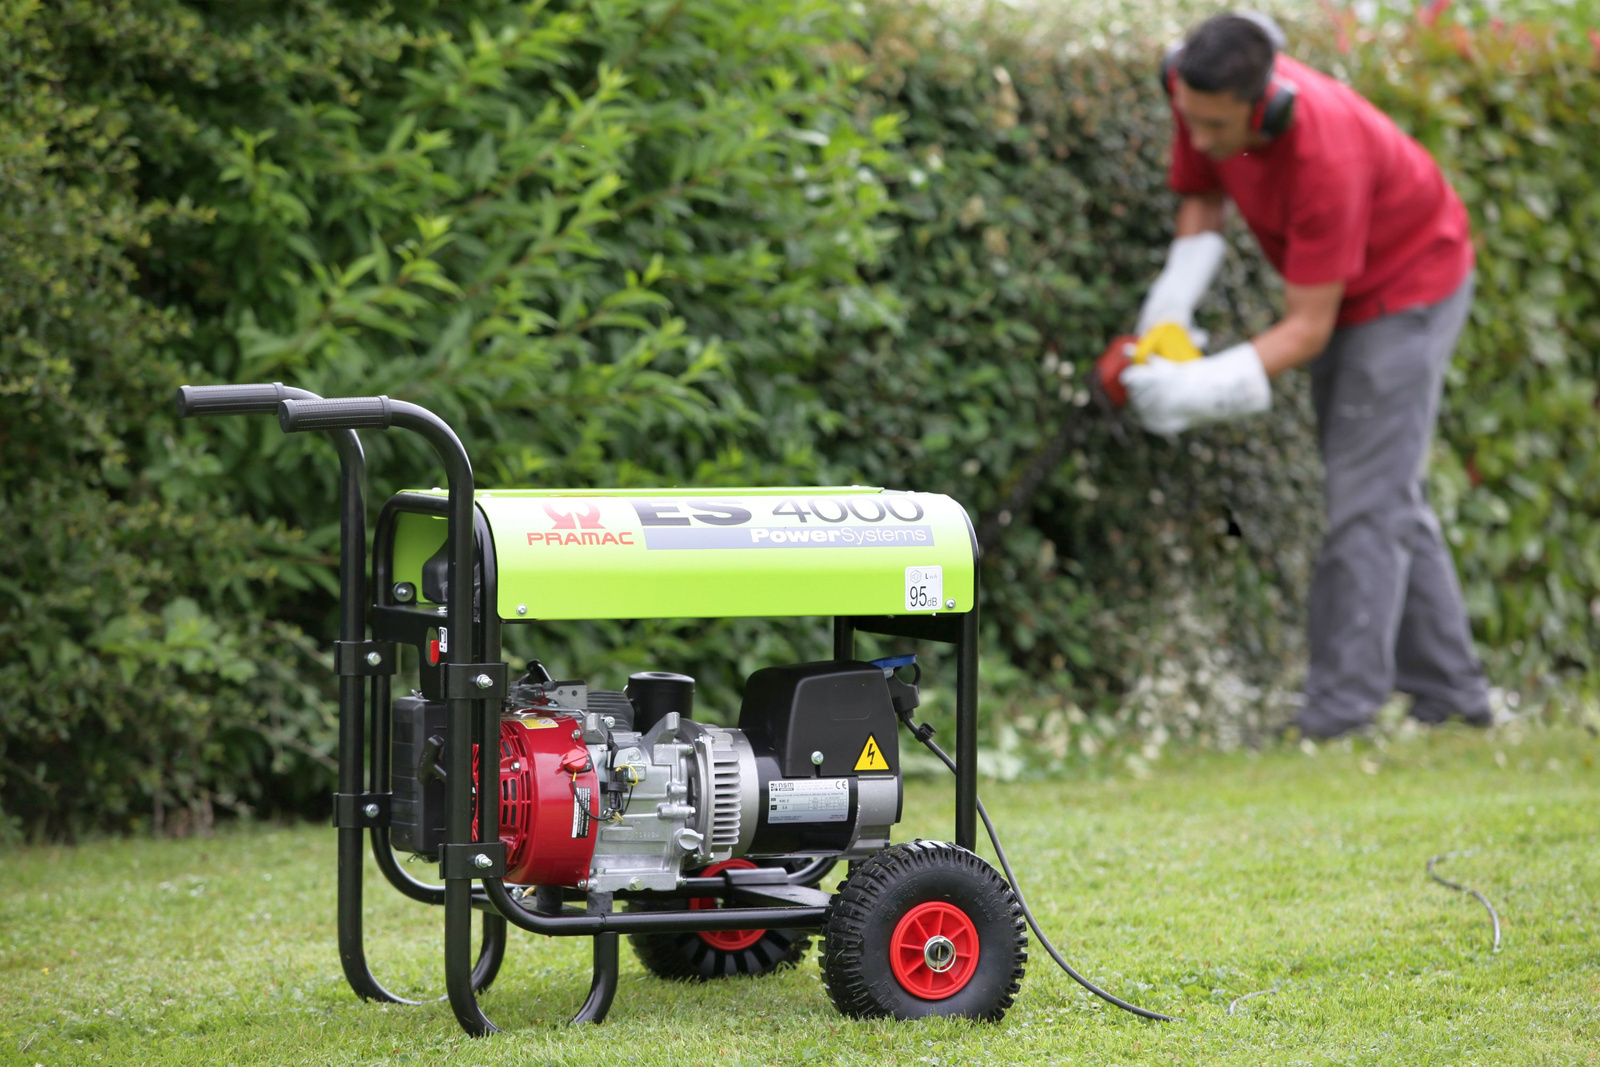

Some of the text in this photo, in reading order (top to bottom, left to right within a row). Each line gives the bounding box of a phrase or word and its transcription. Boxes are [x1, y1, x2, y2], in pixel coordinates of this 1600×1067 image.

[629, 497, 925, 526] ES 4000
[526, 531, 635, 546] PRAMAC
[750, 527, 927, 546] PowerSystems
